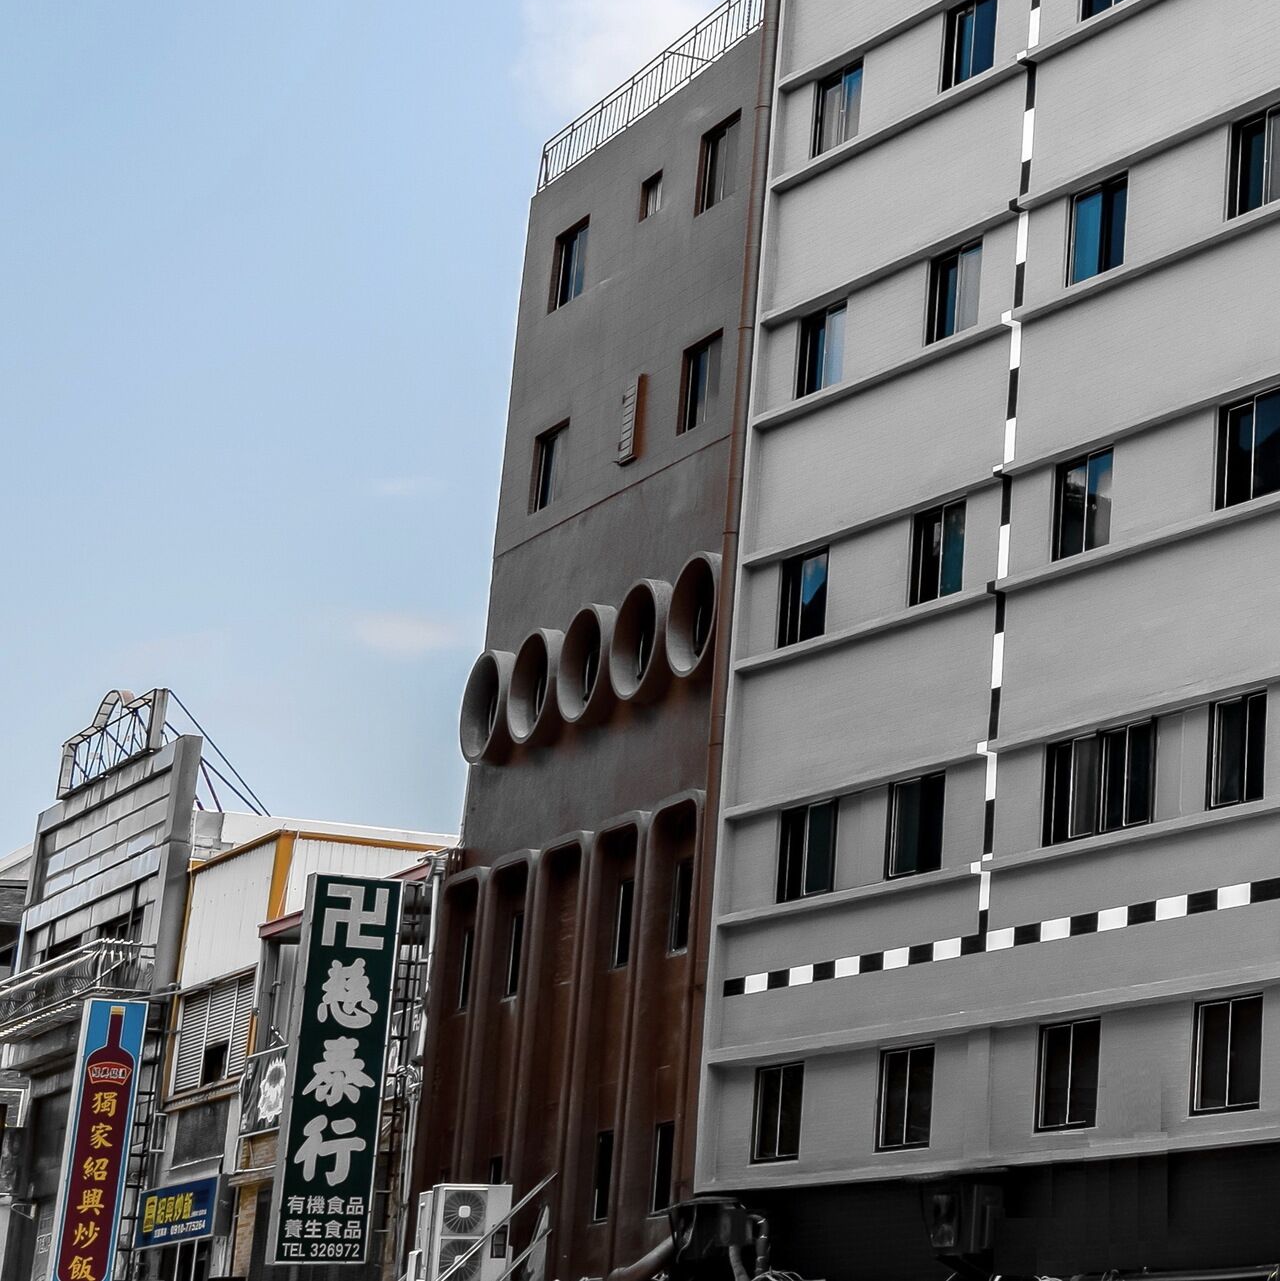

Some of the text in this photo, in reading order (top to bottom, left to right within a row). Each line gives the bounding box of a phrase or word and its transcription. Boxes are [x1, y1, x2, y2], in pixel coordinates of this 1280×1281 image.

[68, 1091, 119, 1281] 獨家紹興炒飯
[287, 1195, 364, 1215] 有機食品
[284, 1219, 362, 1239] 養生食品
[282, 1242, 360, 1258] TEL 326972
